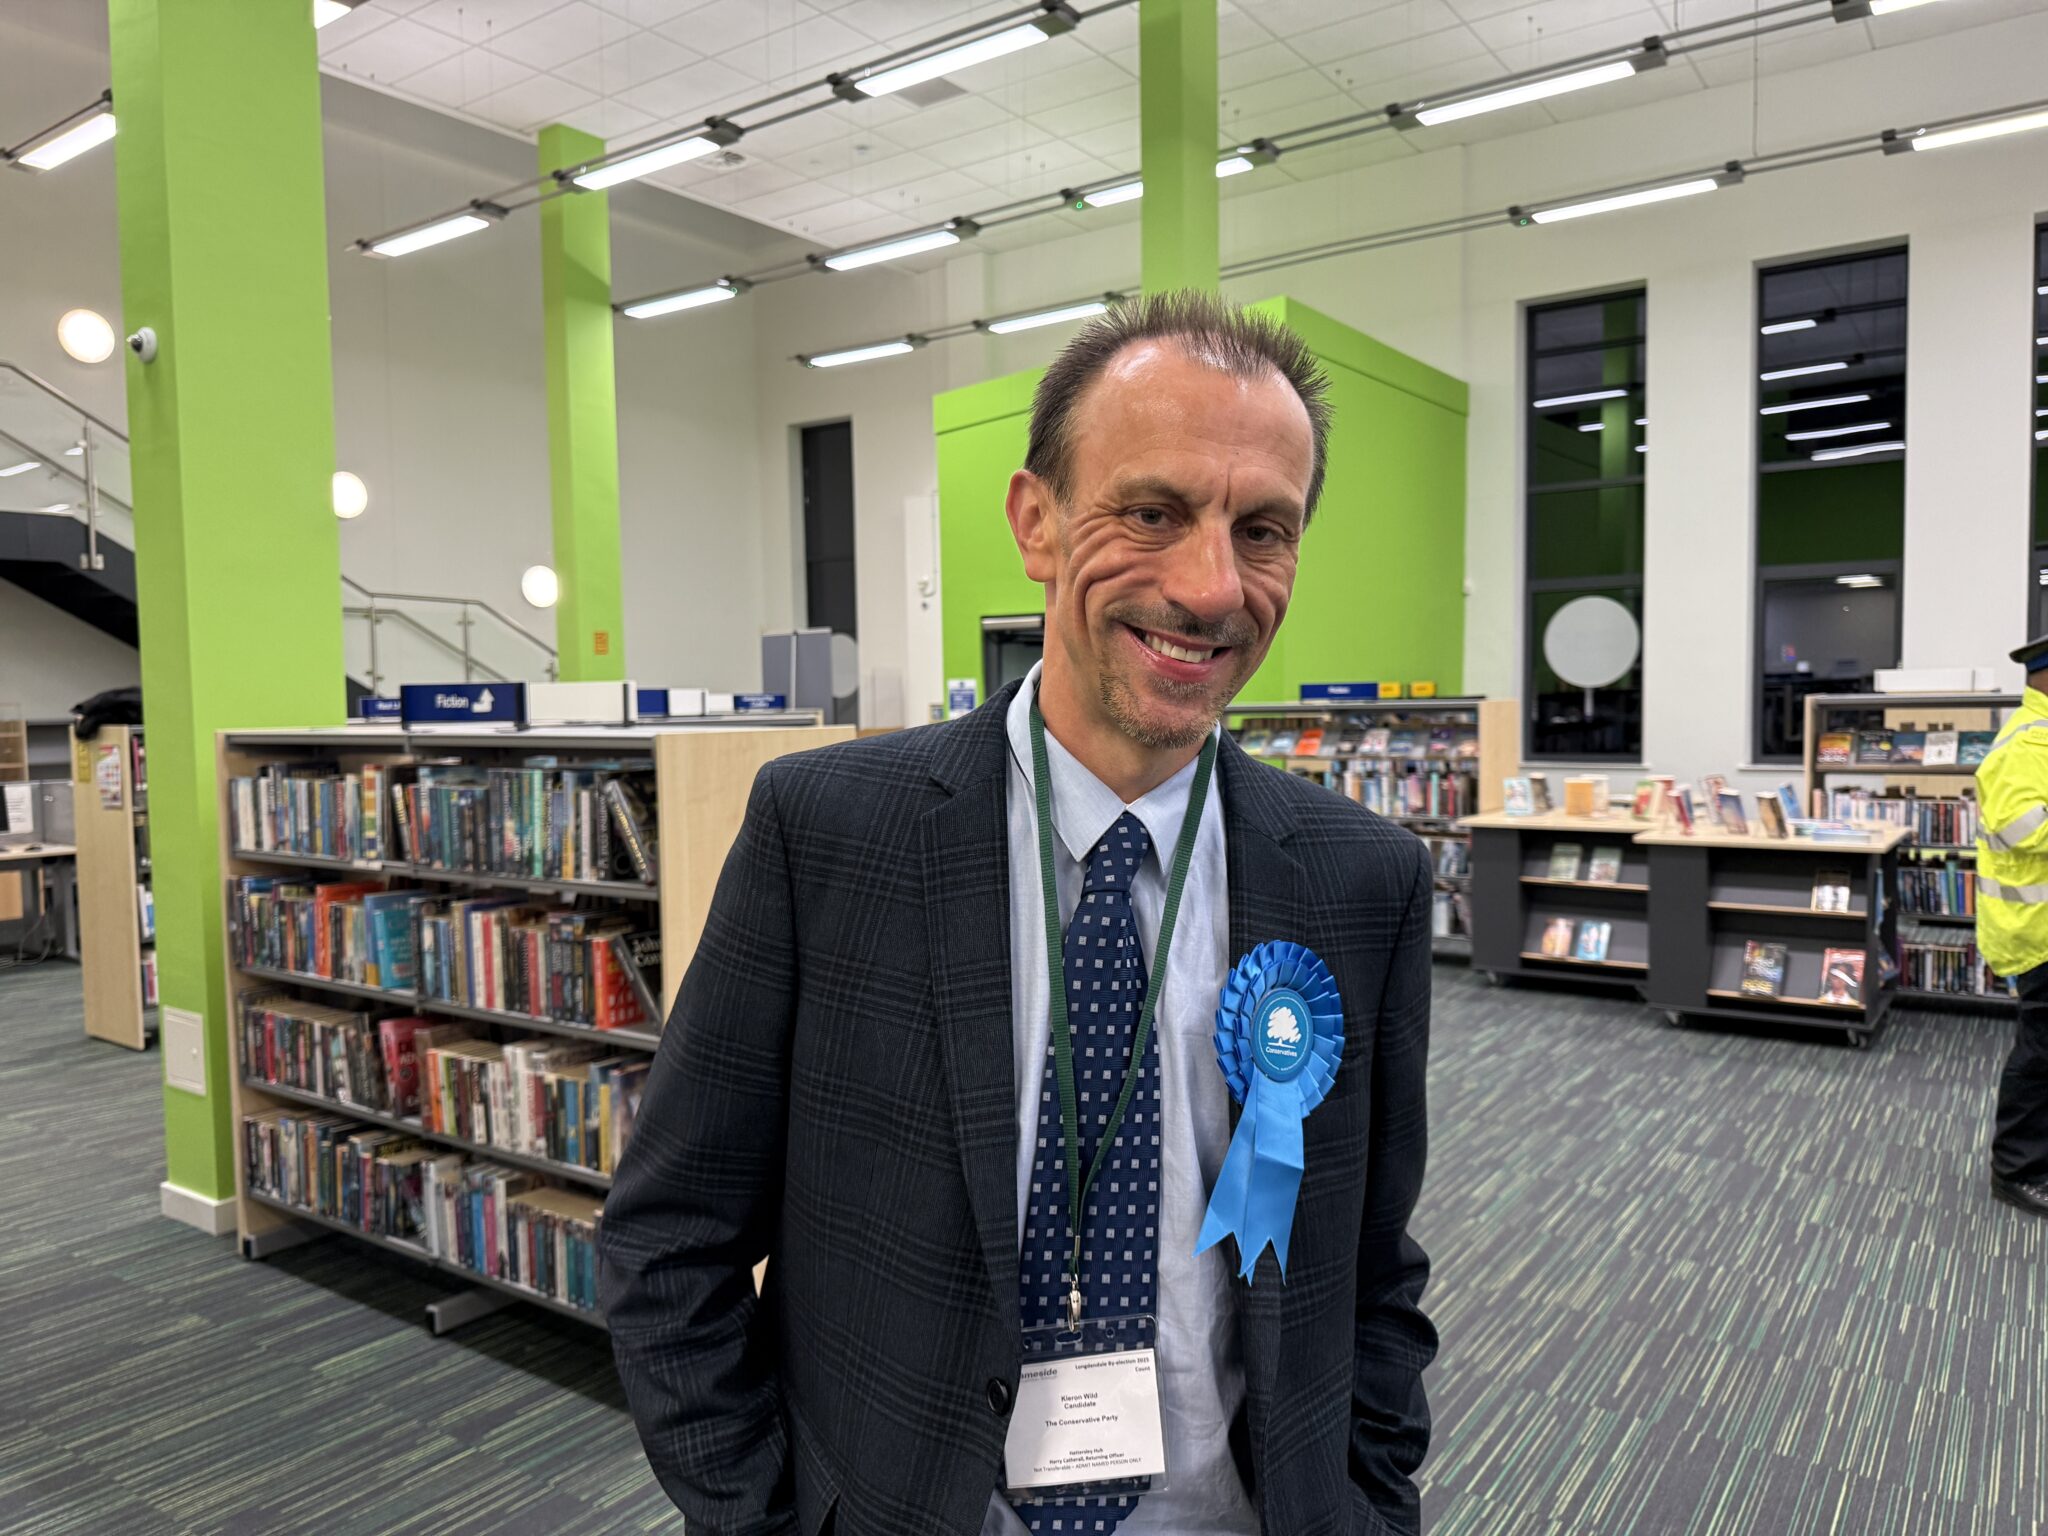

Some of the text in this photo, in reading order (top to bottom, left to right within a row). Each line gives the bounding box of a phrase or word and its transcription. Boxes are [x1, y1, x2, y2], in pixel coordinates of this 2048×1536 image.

[435, 693, 469, 709] Fiction
[1265, 1046, 1298, 1057] Conservatives
[1061, 1392, 1098, 1402] Kieron Wild
[1064, 1401, 1096, 1410] Candidate
[1058, 1416, 1100, 1426] Conservative
[1101, 1414, 1118, 1422] Party
